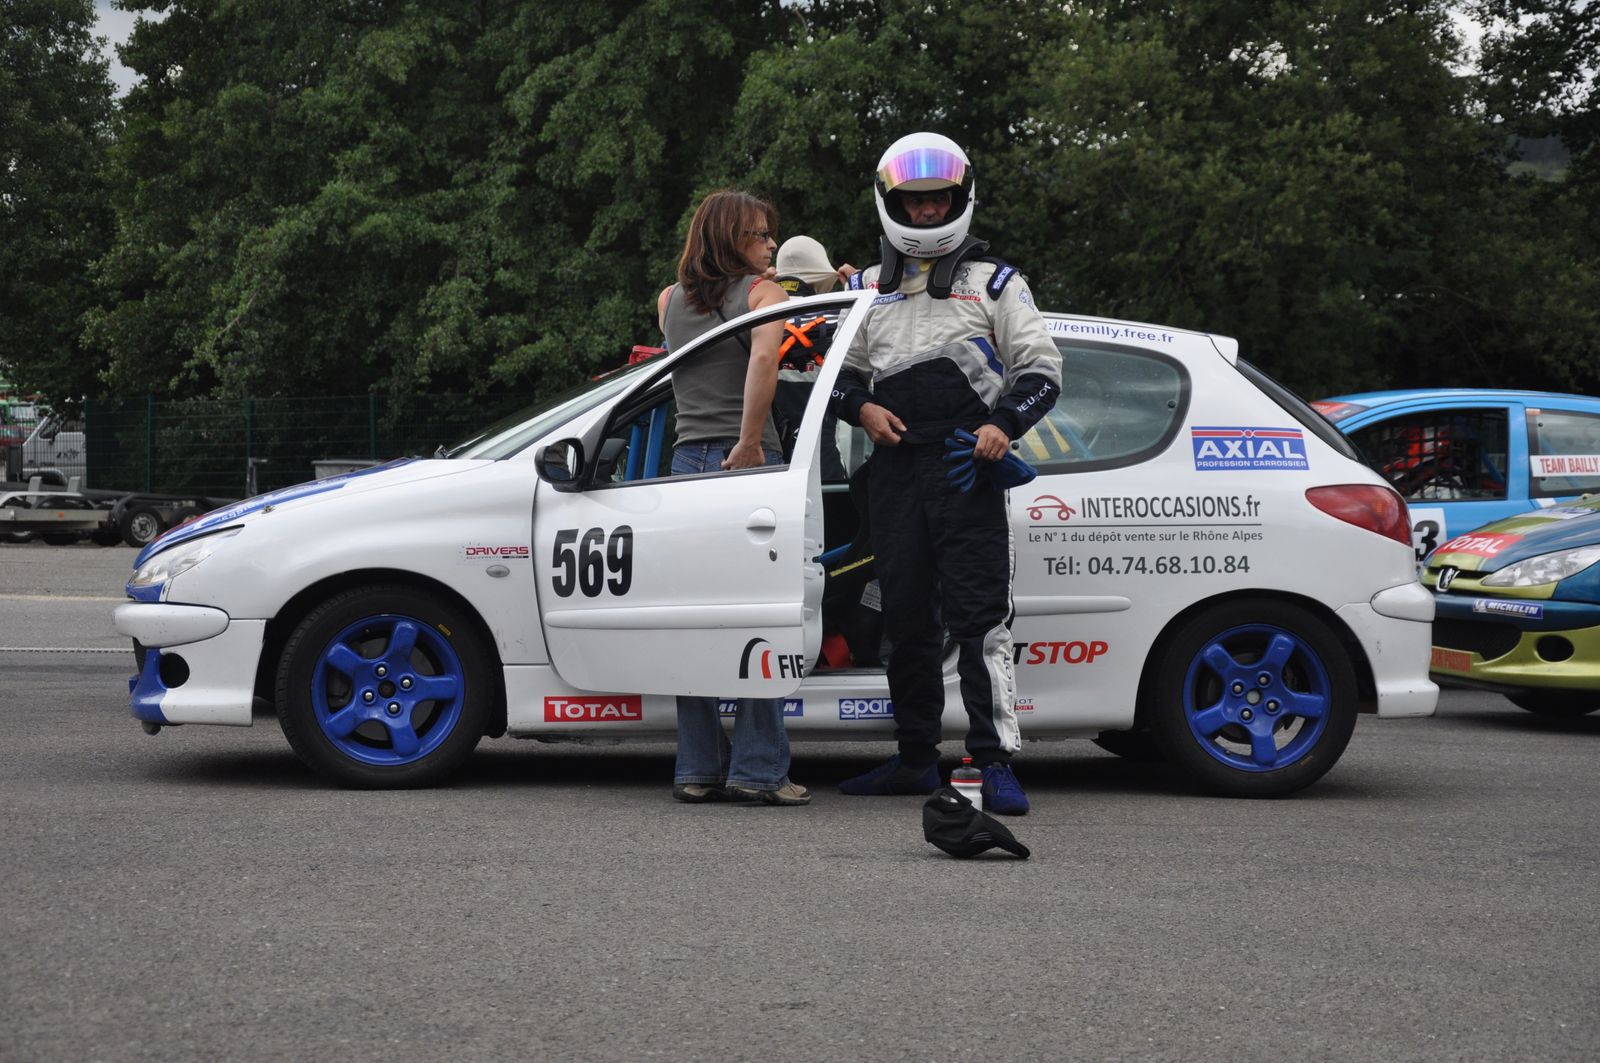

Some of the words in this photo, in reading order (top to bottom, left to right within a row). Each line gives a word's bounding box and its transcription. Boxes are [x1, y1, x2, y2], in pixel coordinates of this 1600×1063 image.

[1049, 321, 1174, 343] ://remilly.free.fr
[1197, 440, 1305, 459] AXIAL
[1540, 458, 1567, 474] TEAM
[1568, 458, 1599, 473] BAILLY
[1081, 494, 1261, 519] INTEROCCASIONS.fr
[1028, 532, 1041, 543] Le
[1061, 532, 1068, 543] 1
[1070, 532, 1085, 542] du
[1088, 531, 1121, 545] dépôt
[1124, 532, 1156, 542] vente
[1158, 533, 1177, 542] sur
[1179, 531, 1190, 542] le
[1193, 530, 1229, 541] Rhône
[1232, 530, 1263, 543] Alpes
[1443, 535, 1504, 554] TOTAL
[466, 546, 529, 555] DRIVERS
[552, 525, 633, 598] 569
[1043, 555, 1081, 575] Tél:
[1088, 555, 1250, 575] 04.74.68.10.84
[1487, 602, 1538, 615] MICHELIN
[1013, 641, 1108, 665] TSTOP
[549, 700, 638, 718] TOTAL
[841, 699, 891, 719] spar
